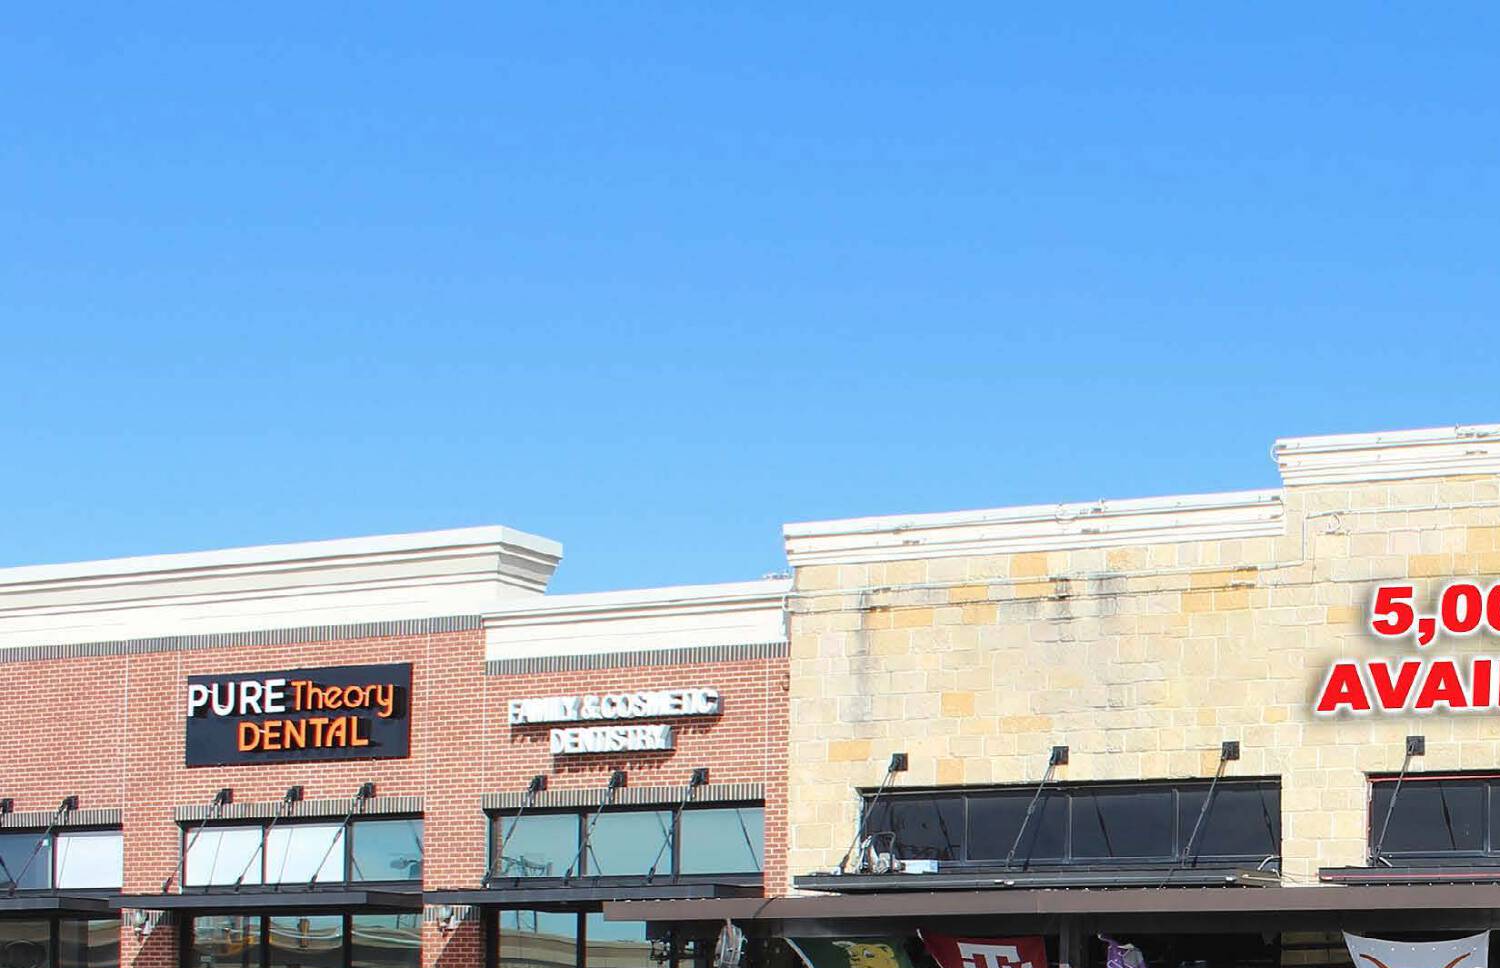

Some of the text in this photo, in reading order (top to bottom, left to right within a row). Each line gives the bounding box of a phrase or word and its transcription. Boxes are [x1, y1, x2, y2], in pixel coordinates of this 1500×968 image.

[187, 678, 394, 717] PURE Theory
[600, 688, 722, 719] COSMETIC
[238, 716, 369, 751] DENTAL
[550, 725, 674, 754] DENTISTRY
